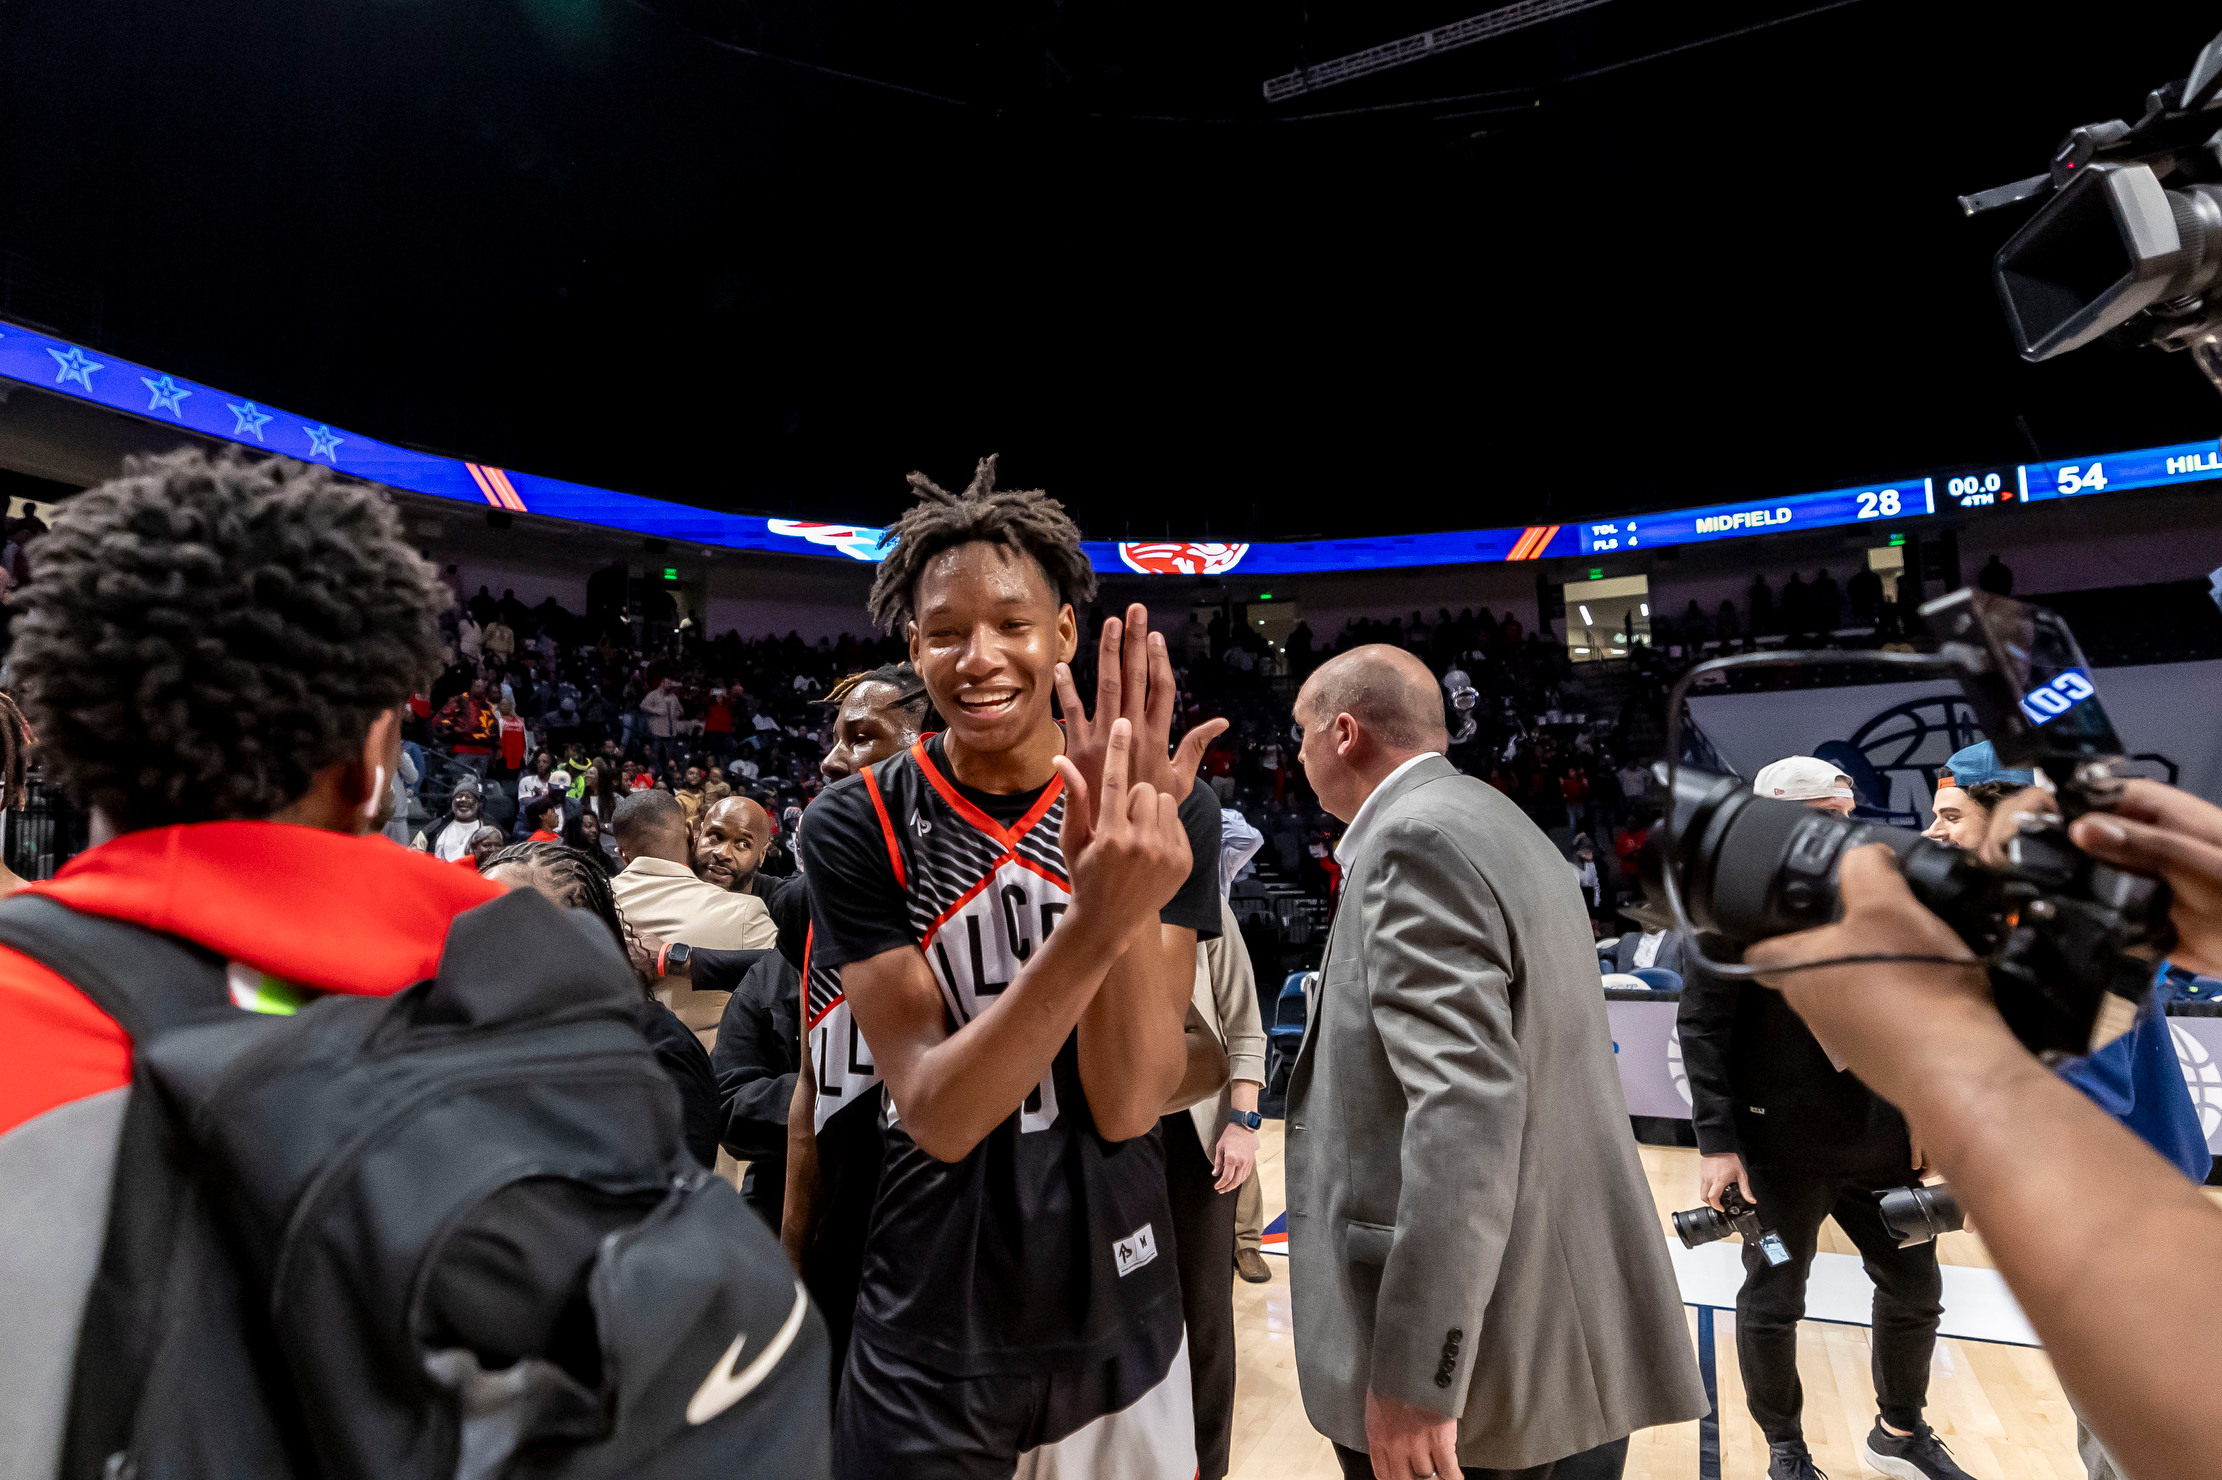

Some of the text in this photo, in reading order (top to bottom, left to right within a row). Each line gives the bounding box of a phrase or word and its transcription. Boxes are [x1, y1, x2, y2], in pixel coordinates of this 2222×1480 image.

[2166, 452, 2222, 475] HILL
[1948, 473, 2001, 497] 00.0
[2057, 462, 2108, 495] 54
[1856, 489, 1902, 519] 28
[1960, 493, 1995, 507] 4TH
[1591, 521, 1637, 536] TOL 4
[1695, 507, 1793, 534] MIDFIELD
[1593, 536, 1638, 551] FLS 4
